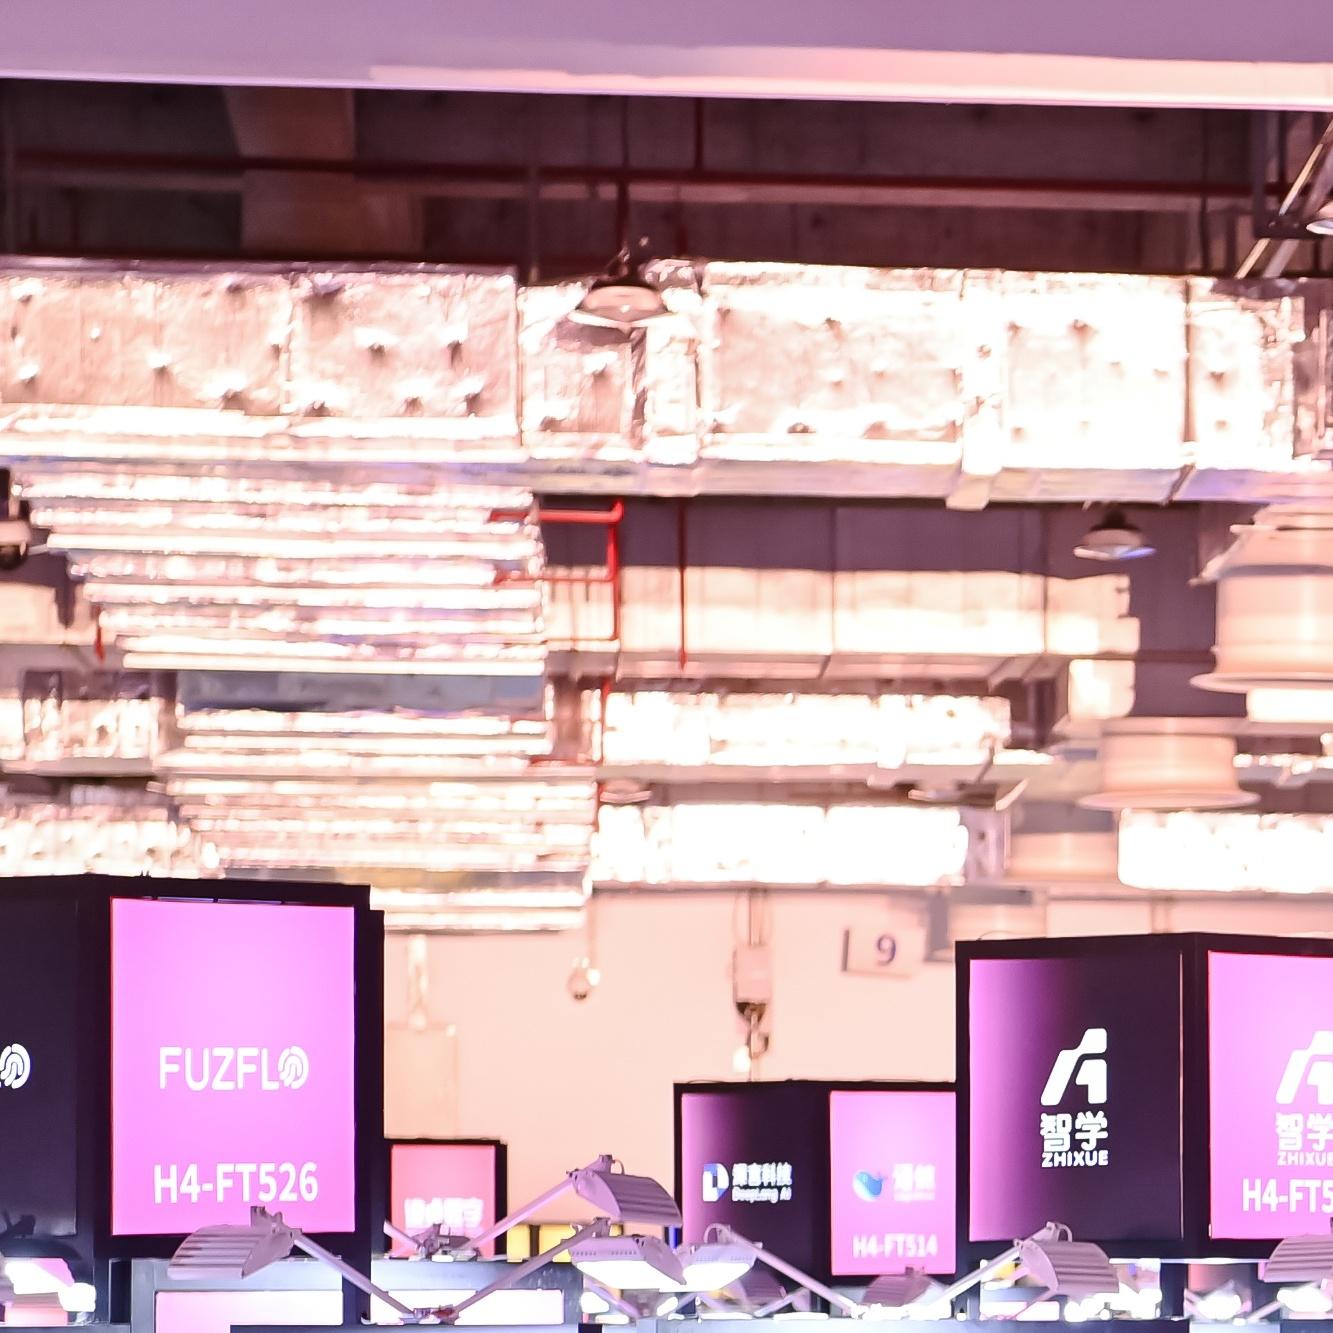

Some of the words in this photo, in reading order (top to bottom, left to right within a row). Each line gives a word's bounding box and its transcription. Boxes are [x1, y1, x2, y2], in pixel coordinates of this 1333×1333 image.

[1040, 1111, 1108, 1151] 智学
[1041, 1150, 1108, 1168] ZHIXUE
[154, 1161, 318, 1203] H4-FT526
